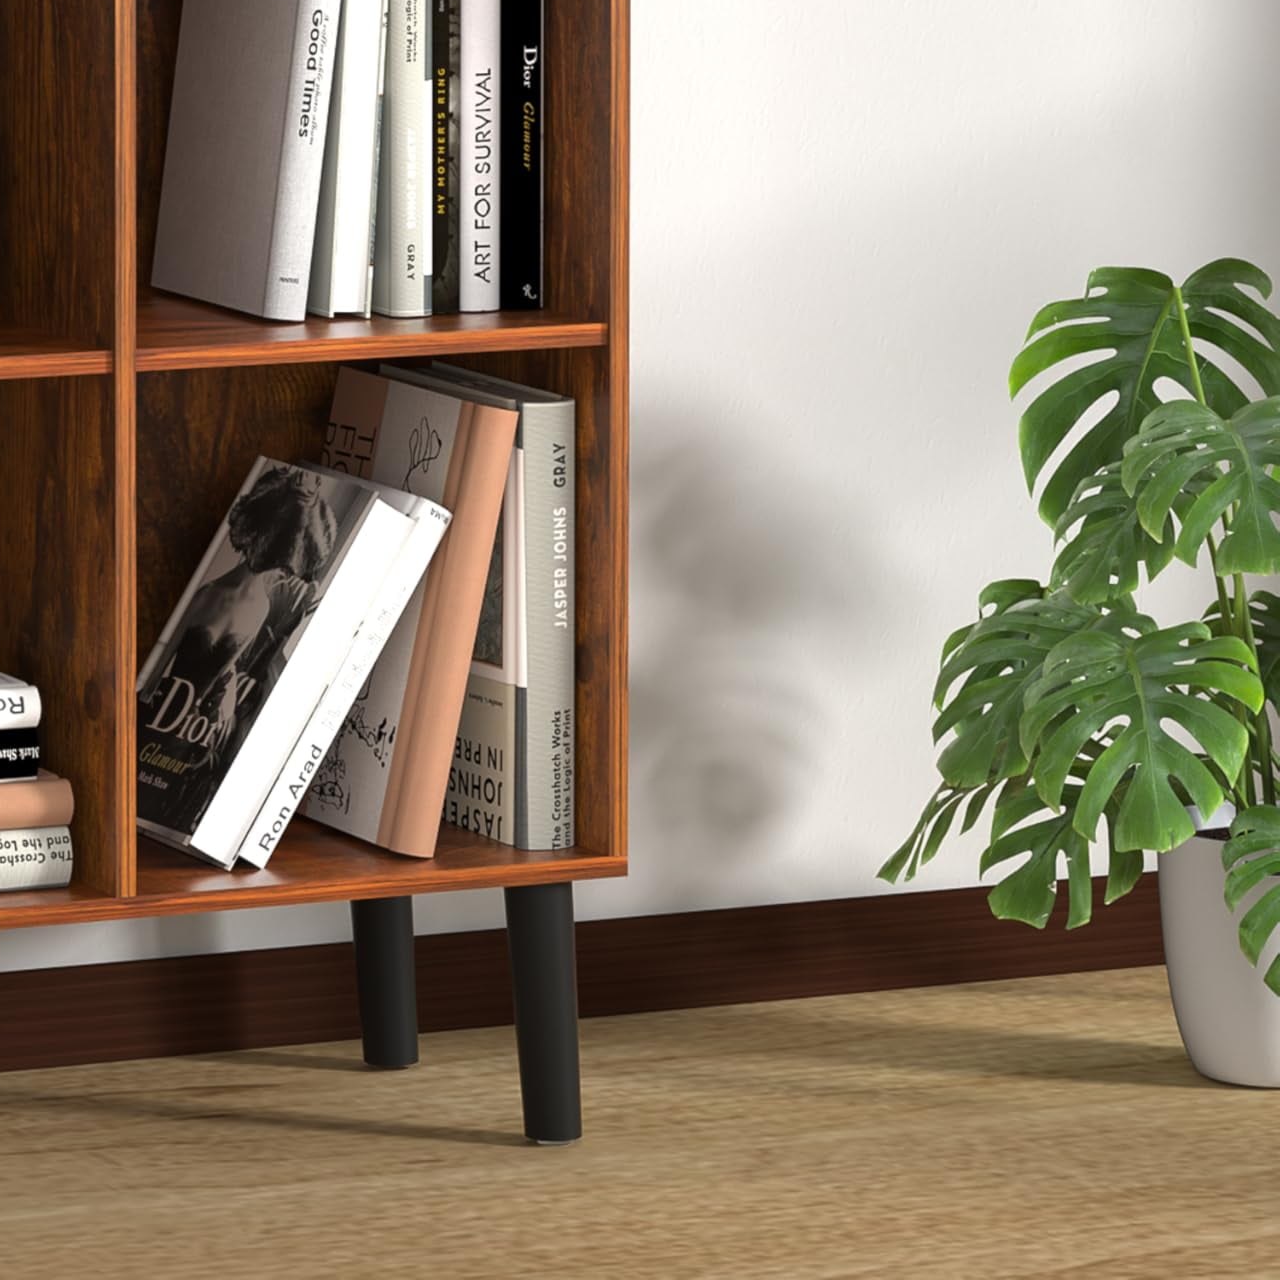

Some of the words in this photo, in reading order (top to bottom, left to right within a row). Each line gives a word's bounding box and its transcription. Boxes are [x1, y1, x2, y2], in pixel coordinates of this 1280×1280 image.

[306, 9, 323, 71] Good
[406, 24, 413, 36] of
[437, 67, 446, 105] RING
[523, 45, 538, 89] Dior
[299, 79, 316, 138] Times
[475, 67, 492, 174] SURVIVAL
[437, 112, 446, 187] MOTHER'S
[522, 101, 535, 171] Glamour
[437, 194, 446, 215] MY
[474, 182, 491, 230] FOR
[406, 244, 415, 281] GRAY
[473, 240, 491, 284] ART
[553, 443, 567, 488] GRAY
[553, 506, 568, 562] JOHNS
[553, 567, 568, 629] JASPER
[145, 676, 221, 748] Dior
[552, 709, 561, 749] Works
[562, 708, 571, 737] Print
[18, 746, 40, 760] Mark
[139, 742, 193, 775] Glamour
[455, 737, 482, 765] PRE
[487, 746, 503, 772] IN
[563, 740, 571, 755] of
[449, 767, 503, 807] JOHNS
[552, 753, 561, 821] Crosshatch
[563, 756, 573, 792] Logic
[258, 804, 291, 852] Ron
[288, 745, 323, 801] Arad
[562, 796, 571, 818] the
[22, 837, 43, 850] the
[45, 835, 71, 848] and
[552, 825, 561, 850] The
[561, 822, 571, 847] and
[50, 849, 72, 862] The
